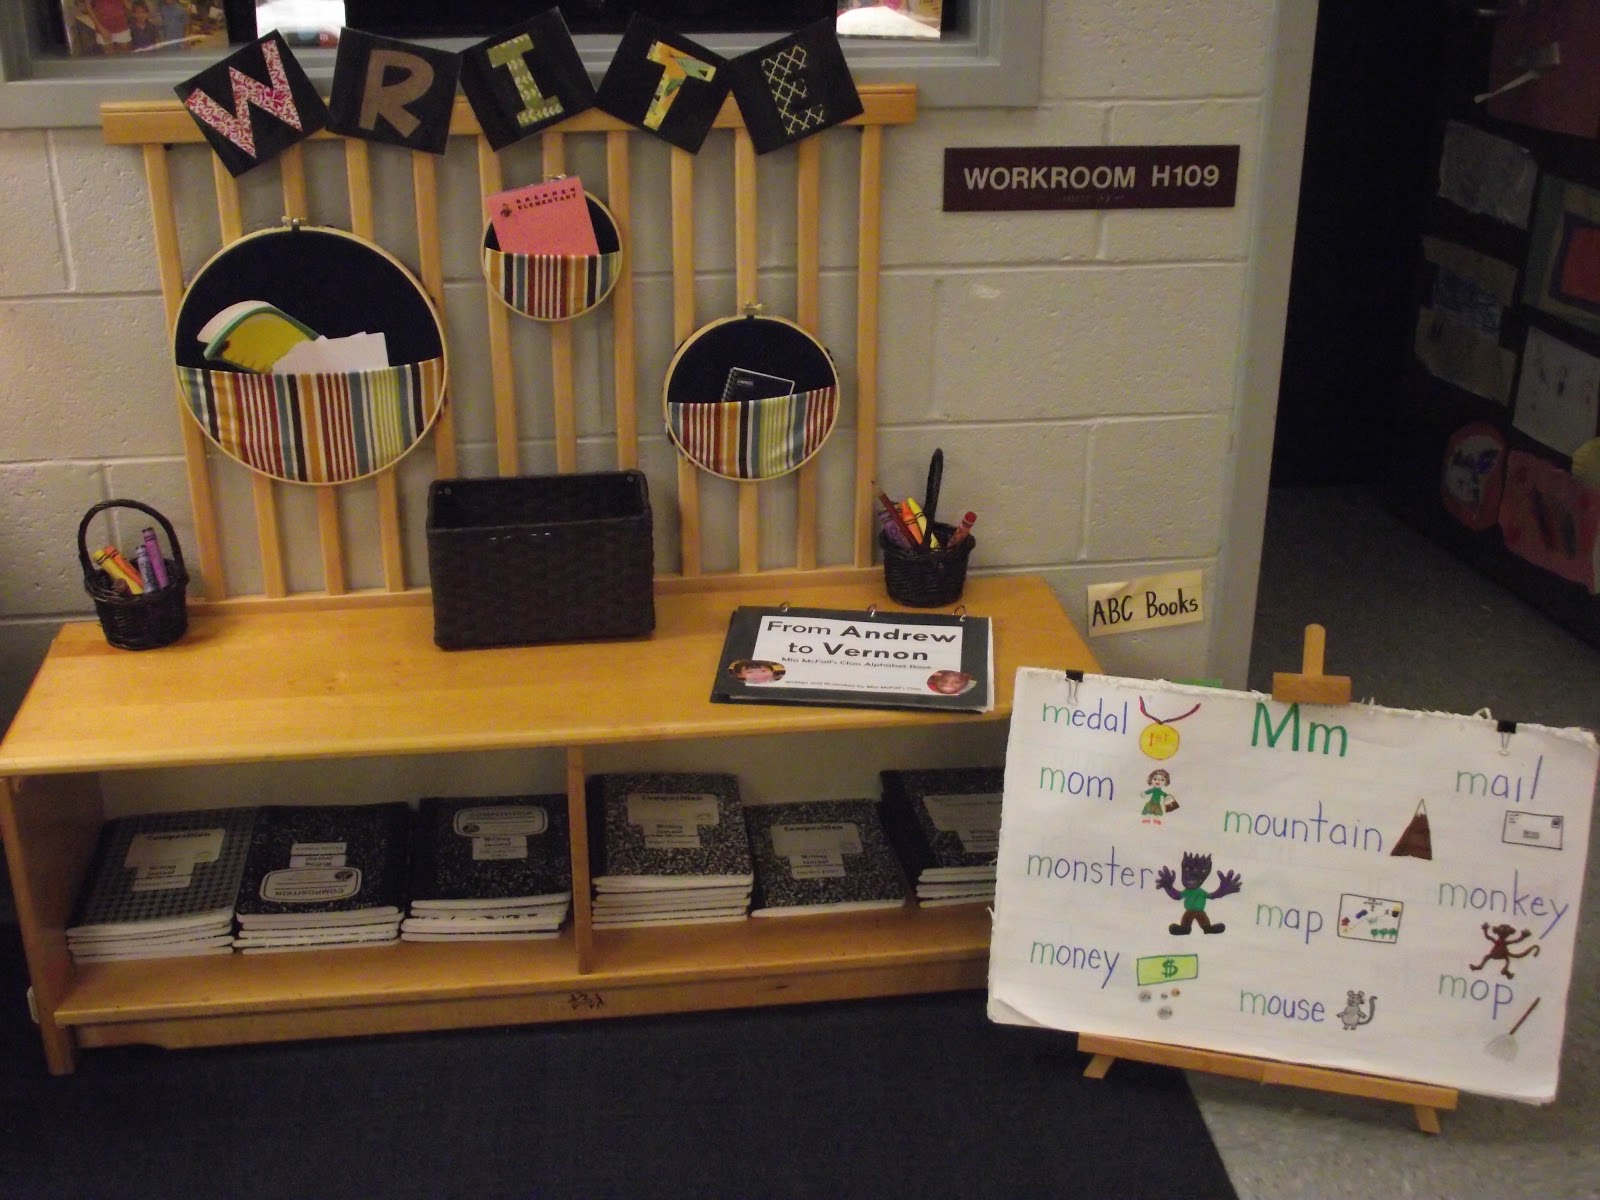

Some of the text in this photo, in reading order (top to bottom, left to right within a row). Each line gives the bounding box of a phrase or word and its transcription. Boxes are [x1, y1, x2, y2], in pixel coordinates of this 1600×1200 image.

[184, 32, 824, 159] WRITE
[963, 164, 1220, 190] WORKROOM H109
[518, 193, 577, 210] ELEMENTARY
[1092, 588, 1199, 626] ABC Books
[767, 620, 958, 643] From Andrew
[788, 642, 929, 661] to Vernon
[863, 661, 907, 669] Alphabet
[1041, 697, 1128, 735] medal
[1250, 701, 1348, 758] Mm
[1039, 766, 1115, 801] mom
[1456, 755, 1545, 801] mail
[1223, 800, 1384, 853] mountain
[1026, 845, 1154, 890] monster
[275, 887, 344, 896] COMPOSITION
[1437, 868, 1570, 940] monkey
[1255, 902, 1324, 945] map
[1029, 938, 1121, 989] money
[1161, 958, 1179, 978] $
[1239, 988, 1327, 1024] mouse
[1437, 972, 1515, 1021] mop
